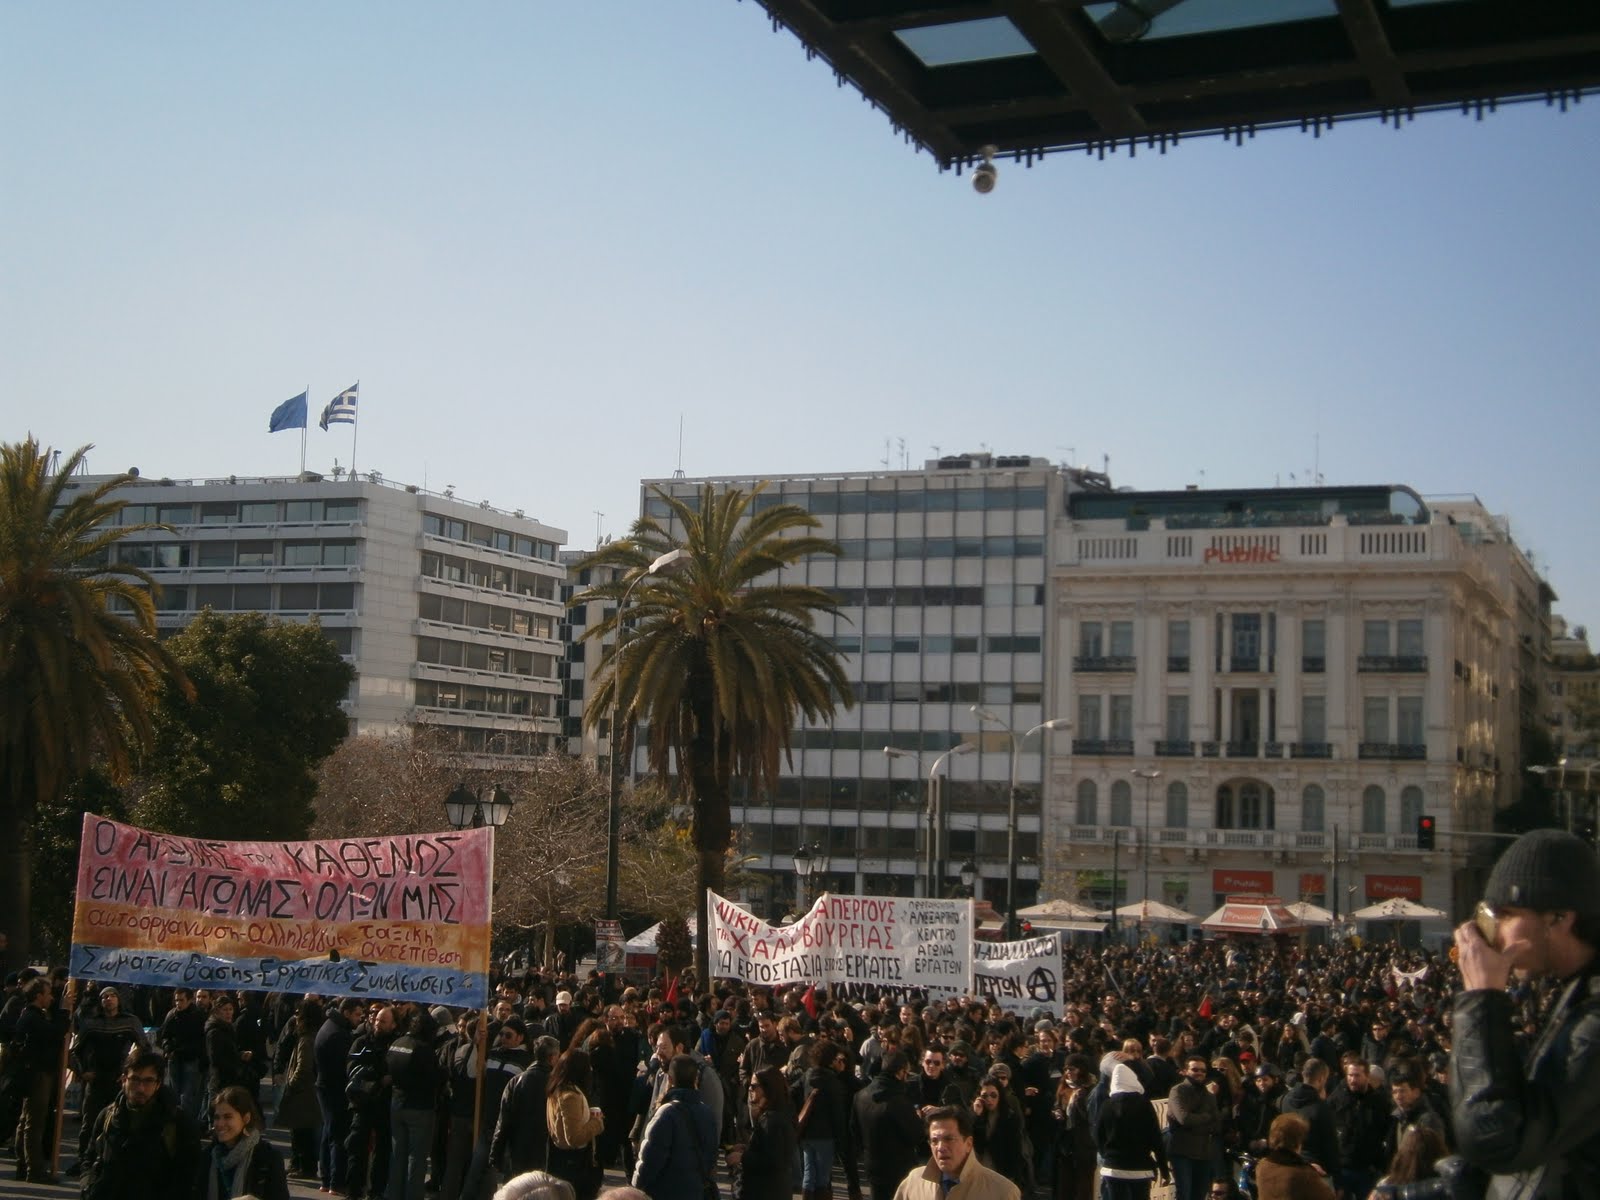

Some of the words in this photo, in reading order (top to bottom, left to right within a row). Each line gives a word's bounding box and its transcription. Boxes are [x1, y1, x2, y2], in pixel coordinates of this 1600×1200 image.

[1204, 544, 1279, 564] Public
[96, 820, 116, 855] Ο
[129, 827, 243, 872] ΑΓΩΝΑΣ
[283, 836, 463, 879] ΚΑΘΕΝΟΣ
[91, 866, 168, 907] ΕΙΝΑΙ
[178, 871, 302, 919] ΑΓΩΝΑΣ
[315, 881, 397, 921] ΟΛΩΝ
[402, 882, 460, 924] ΜΑΣ
[715, 901, 760, 935] ΝΙΚΗ
[814, 898, 896, 924] ΑΠΕΡΓΟΥΣ
[917, 928, 956, 941] ΚΕΝΤΡΟ
[917, 943, 954, 957] ΑΓΩΝΑ
[738, 954, 822, 982] ΕΡΓΟΣΤΑΣΙΑ
[846, 955, 902, 980] ΕΡΓΑΤΕΣ
[915, 958, 961, 974] ΕΡΓΑΤΩΝ
